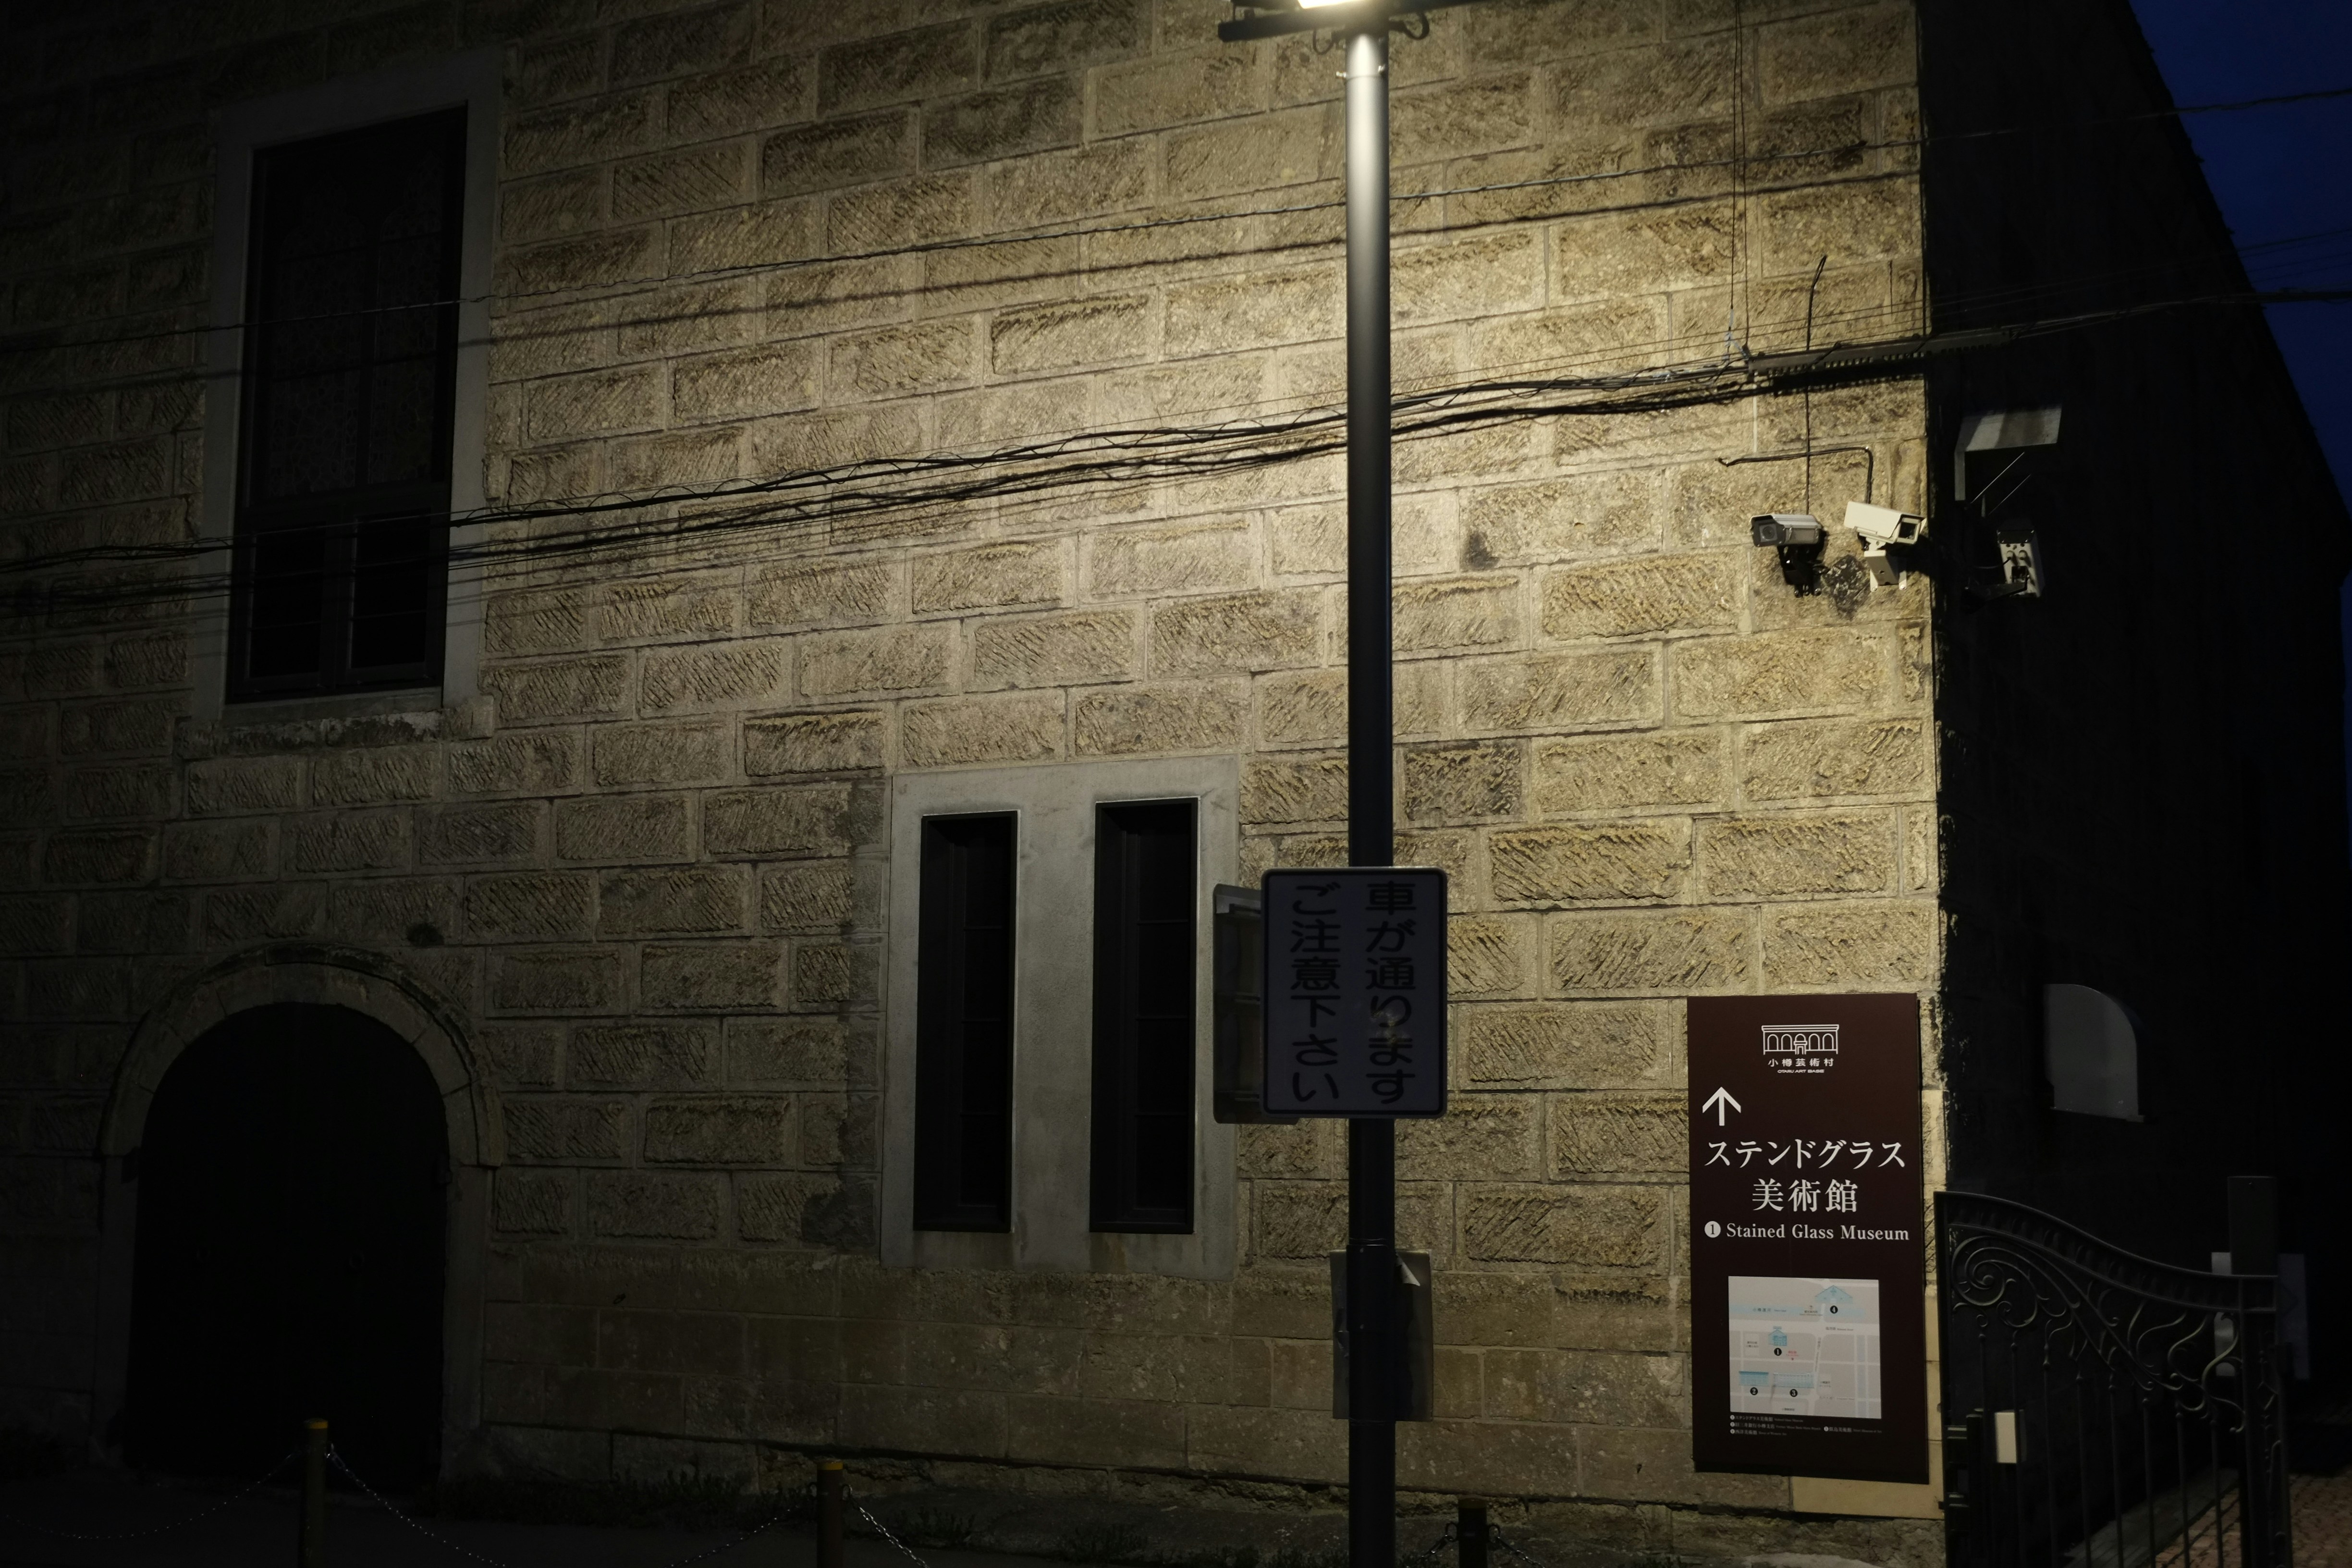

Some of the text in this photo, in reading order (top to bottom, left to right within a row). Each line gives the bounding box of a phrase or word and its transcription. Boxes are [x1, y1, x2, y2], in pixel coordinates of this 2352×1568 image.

[1290, 882, 1341, 1102] ご注意下さい
[1365, 881, 1417, 1103] 車が通ります
[1768, 1058, 1834, 1067] 小樽芸術村
[1704, 1139, 1906, 1169] ステンドグラス
[1752, 1178, 1858, 1213] 美術館
[1726, 1223, 1786, 1238] Stained
[1792, 1224, 1834, 1239] Glass
[1840, 1225, 1909, 1240] Museum
